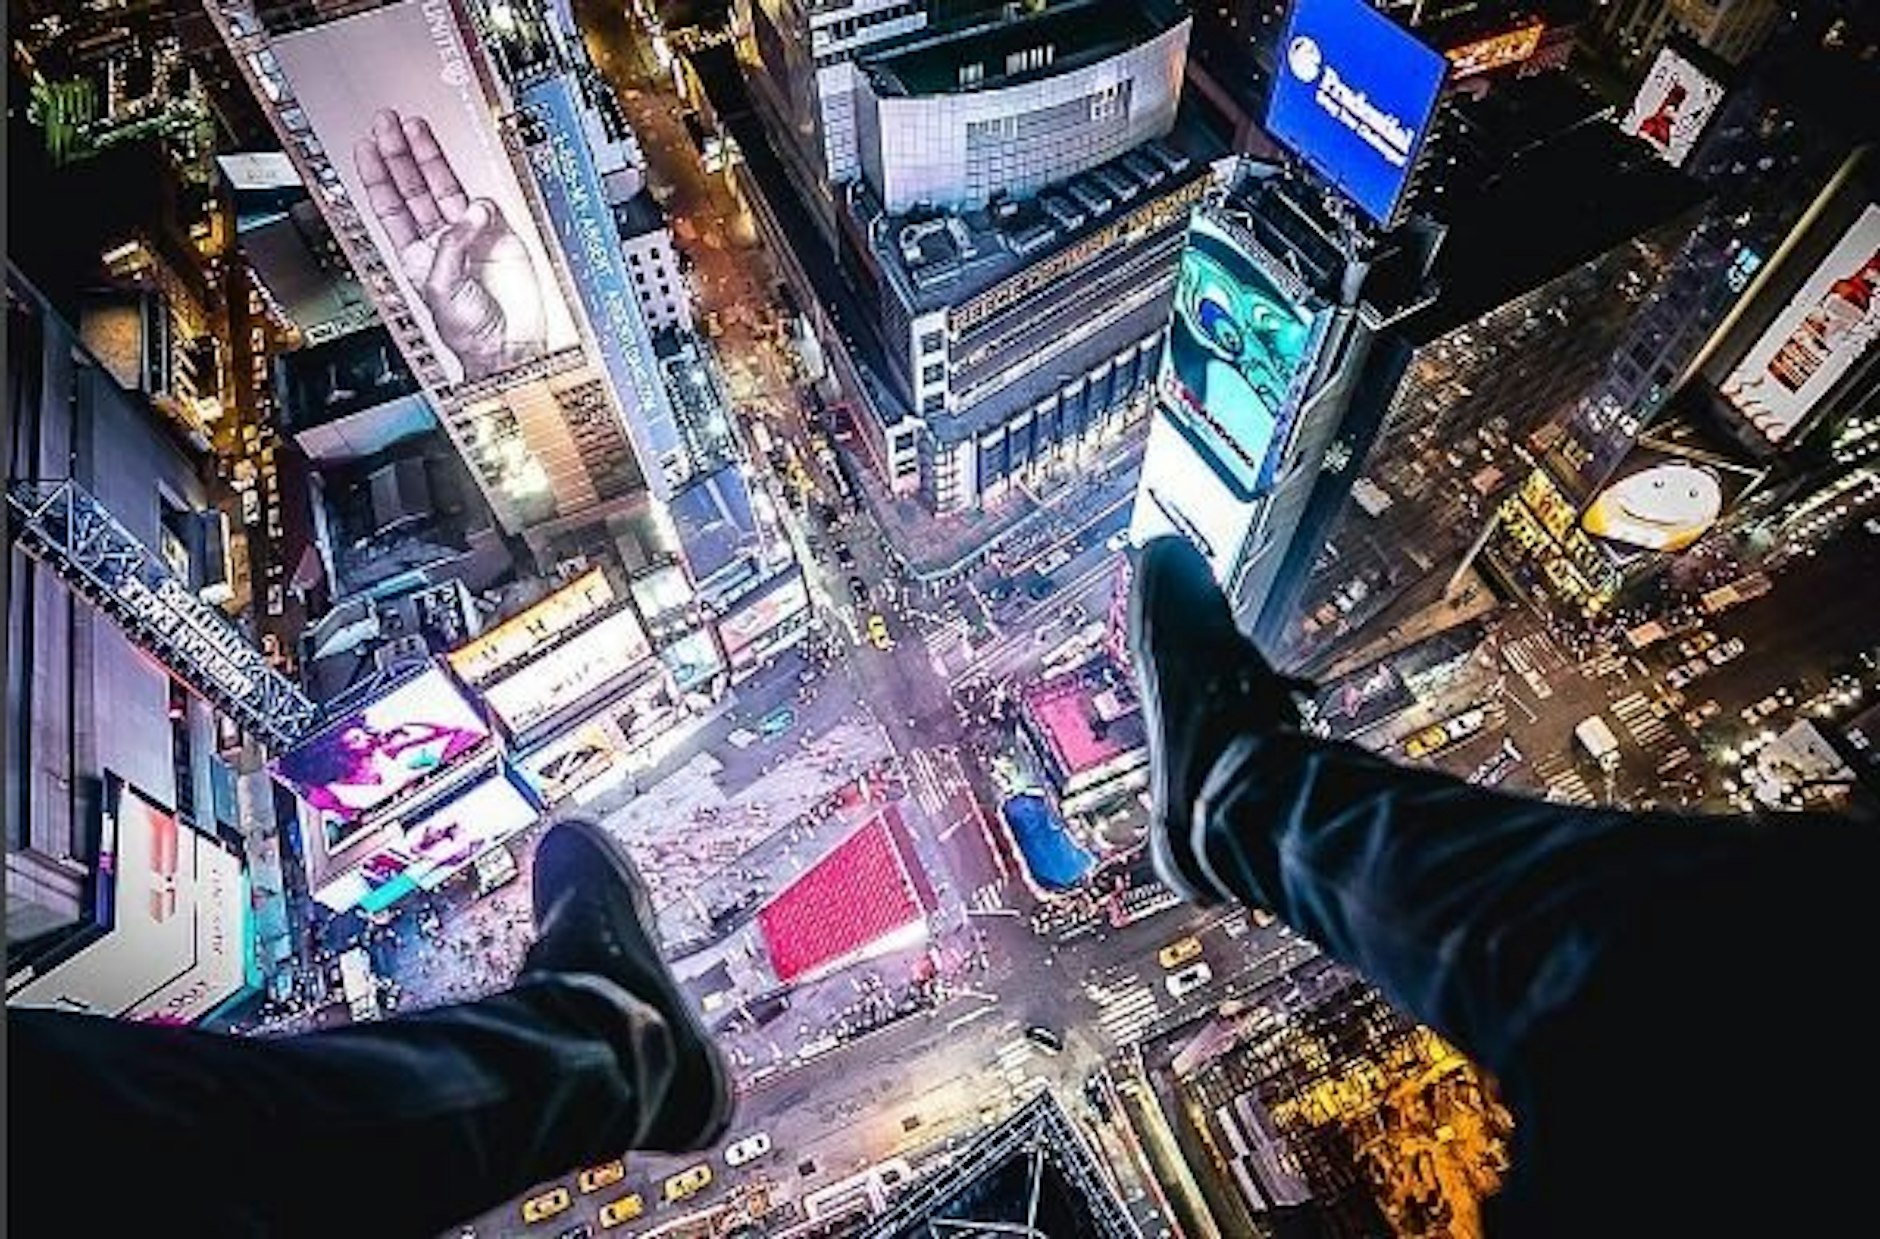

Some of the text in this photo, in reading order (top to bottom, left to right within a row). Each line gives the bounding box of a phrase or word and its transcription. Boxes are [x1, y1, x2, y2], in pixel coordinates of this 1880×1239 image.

[116, 574, 254, 699] AMERICAN EAGLE
[156, 579, 253, 668] OUTFITTERS
